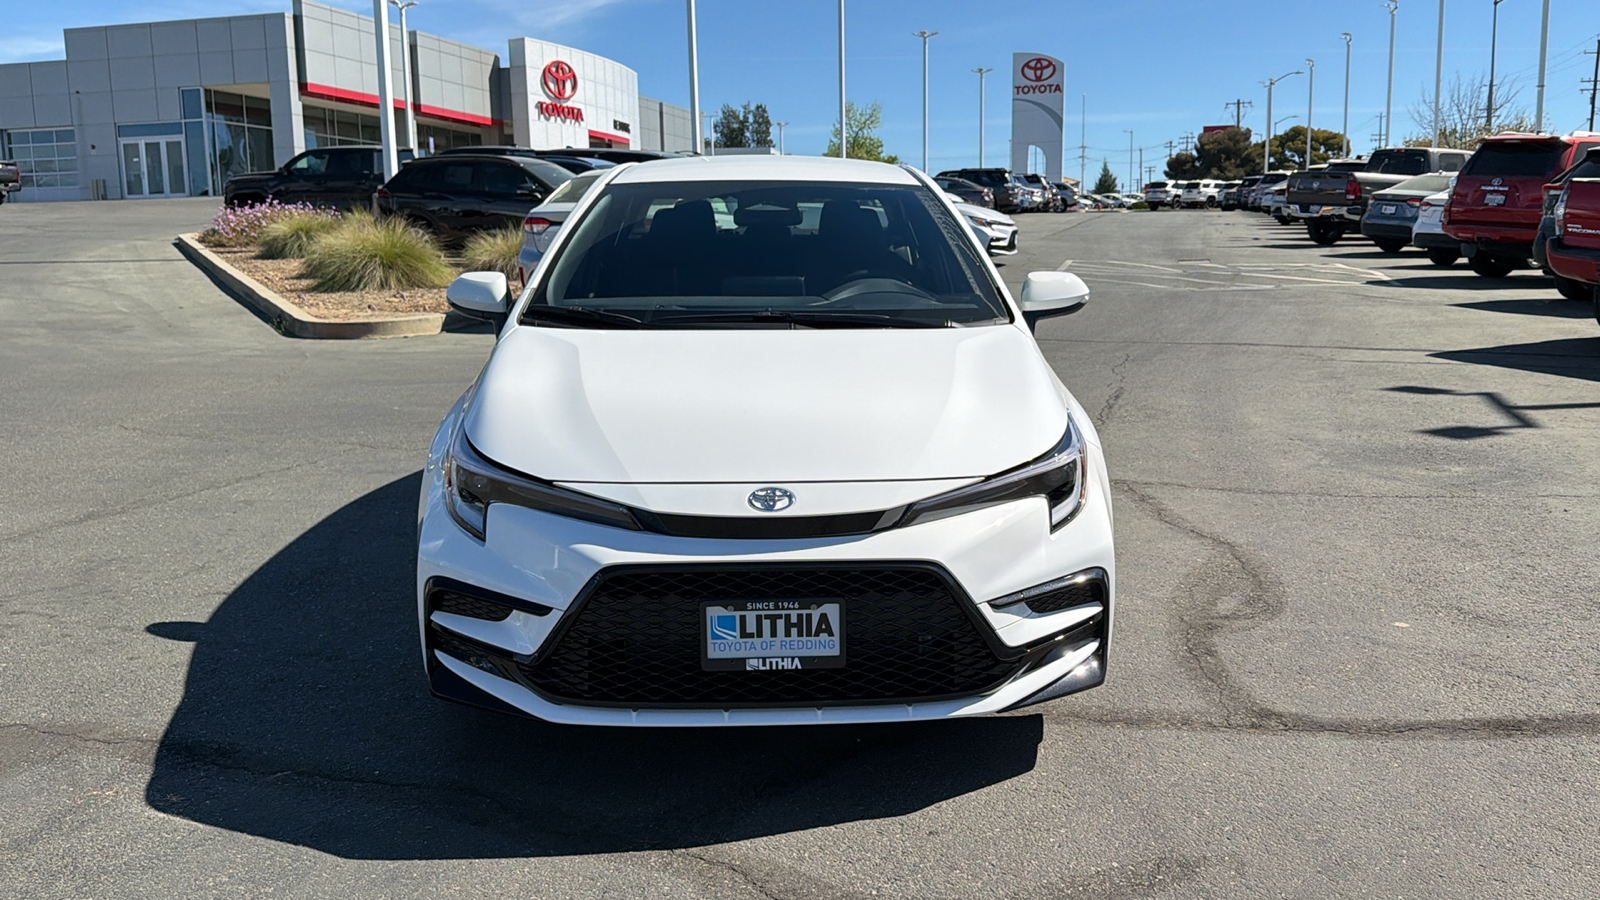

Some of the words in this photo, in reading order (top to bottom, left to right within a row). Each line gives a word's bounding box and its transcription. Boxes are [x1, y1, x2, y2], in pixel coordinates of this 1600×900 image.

[1014, 84, 1062, 95] TOYOTA
[537, 101, 584, 121] TOYOTA
[778, 601, 800, 609] 1946
[739, 613, 835, 639] LITHIA
[711, 641, 757, 652] TOYOTA
[760, 641, 776, 650] OF
[780, 639, 836, 650] REDDING
[759, 658, 802, 669] LITHIA
